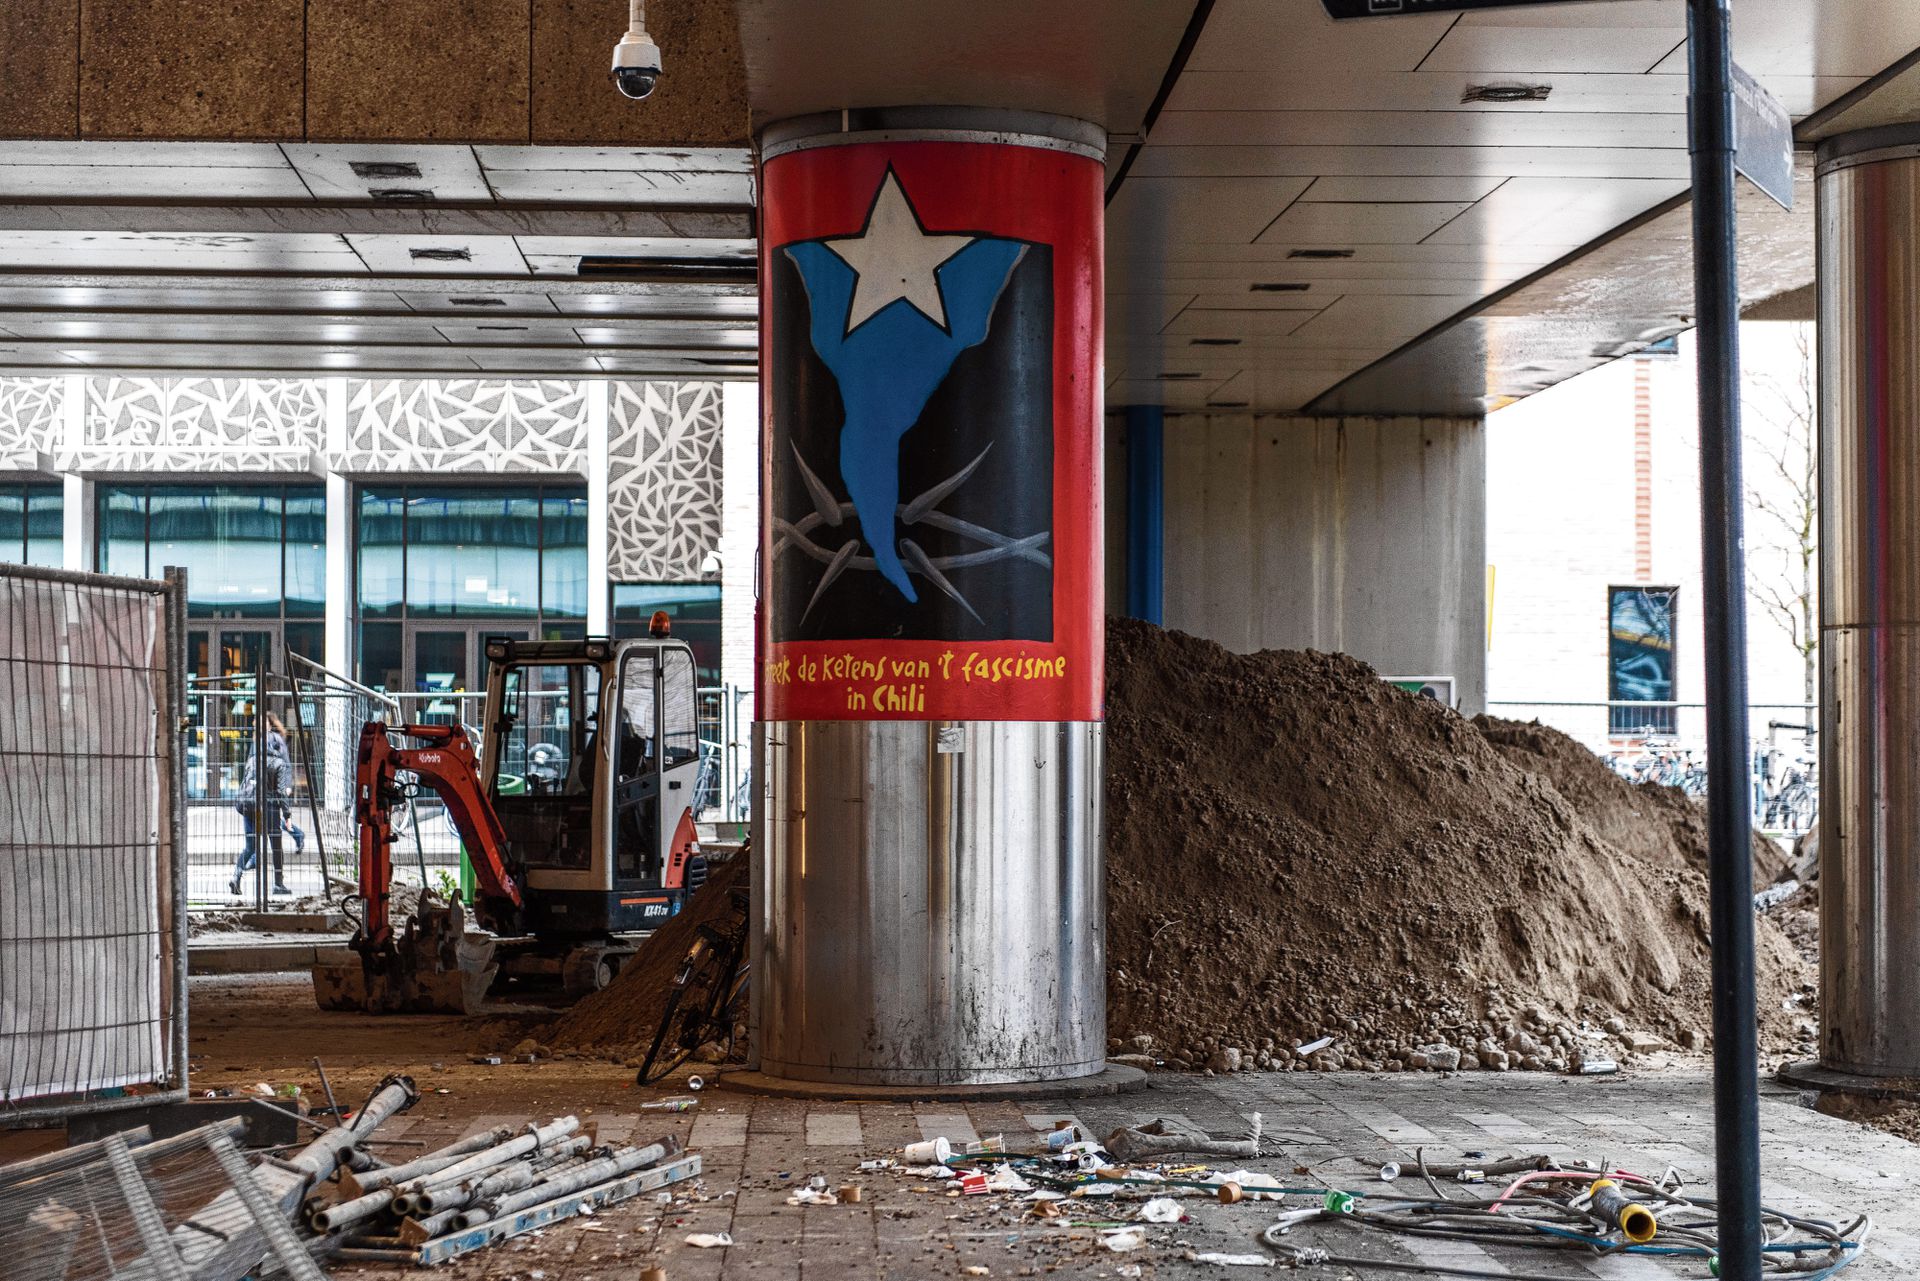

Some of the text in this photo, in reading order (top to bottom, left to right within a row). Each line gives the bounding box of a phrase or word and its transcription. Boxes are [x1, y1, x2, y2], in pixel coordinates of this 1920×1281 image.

[798, 654, 816, 682] de
[891, 660, 930, 678] van
[961, 650, 1066, 682] fascisme
[847, 683, 925, 712] in Chili
[418, 752, 441, 763] Kubota
